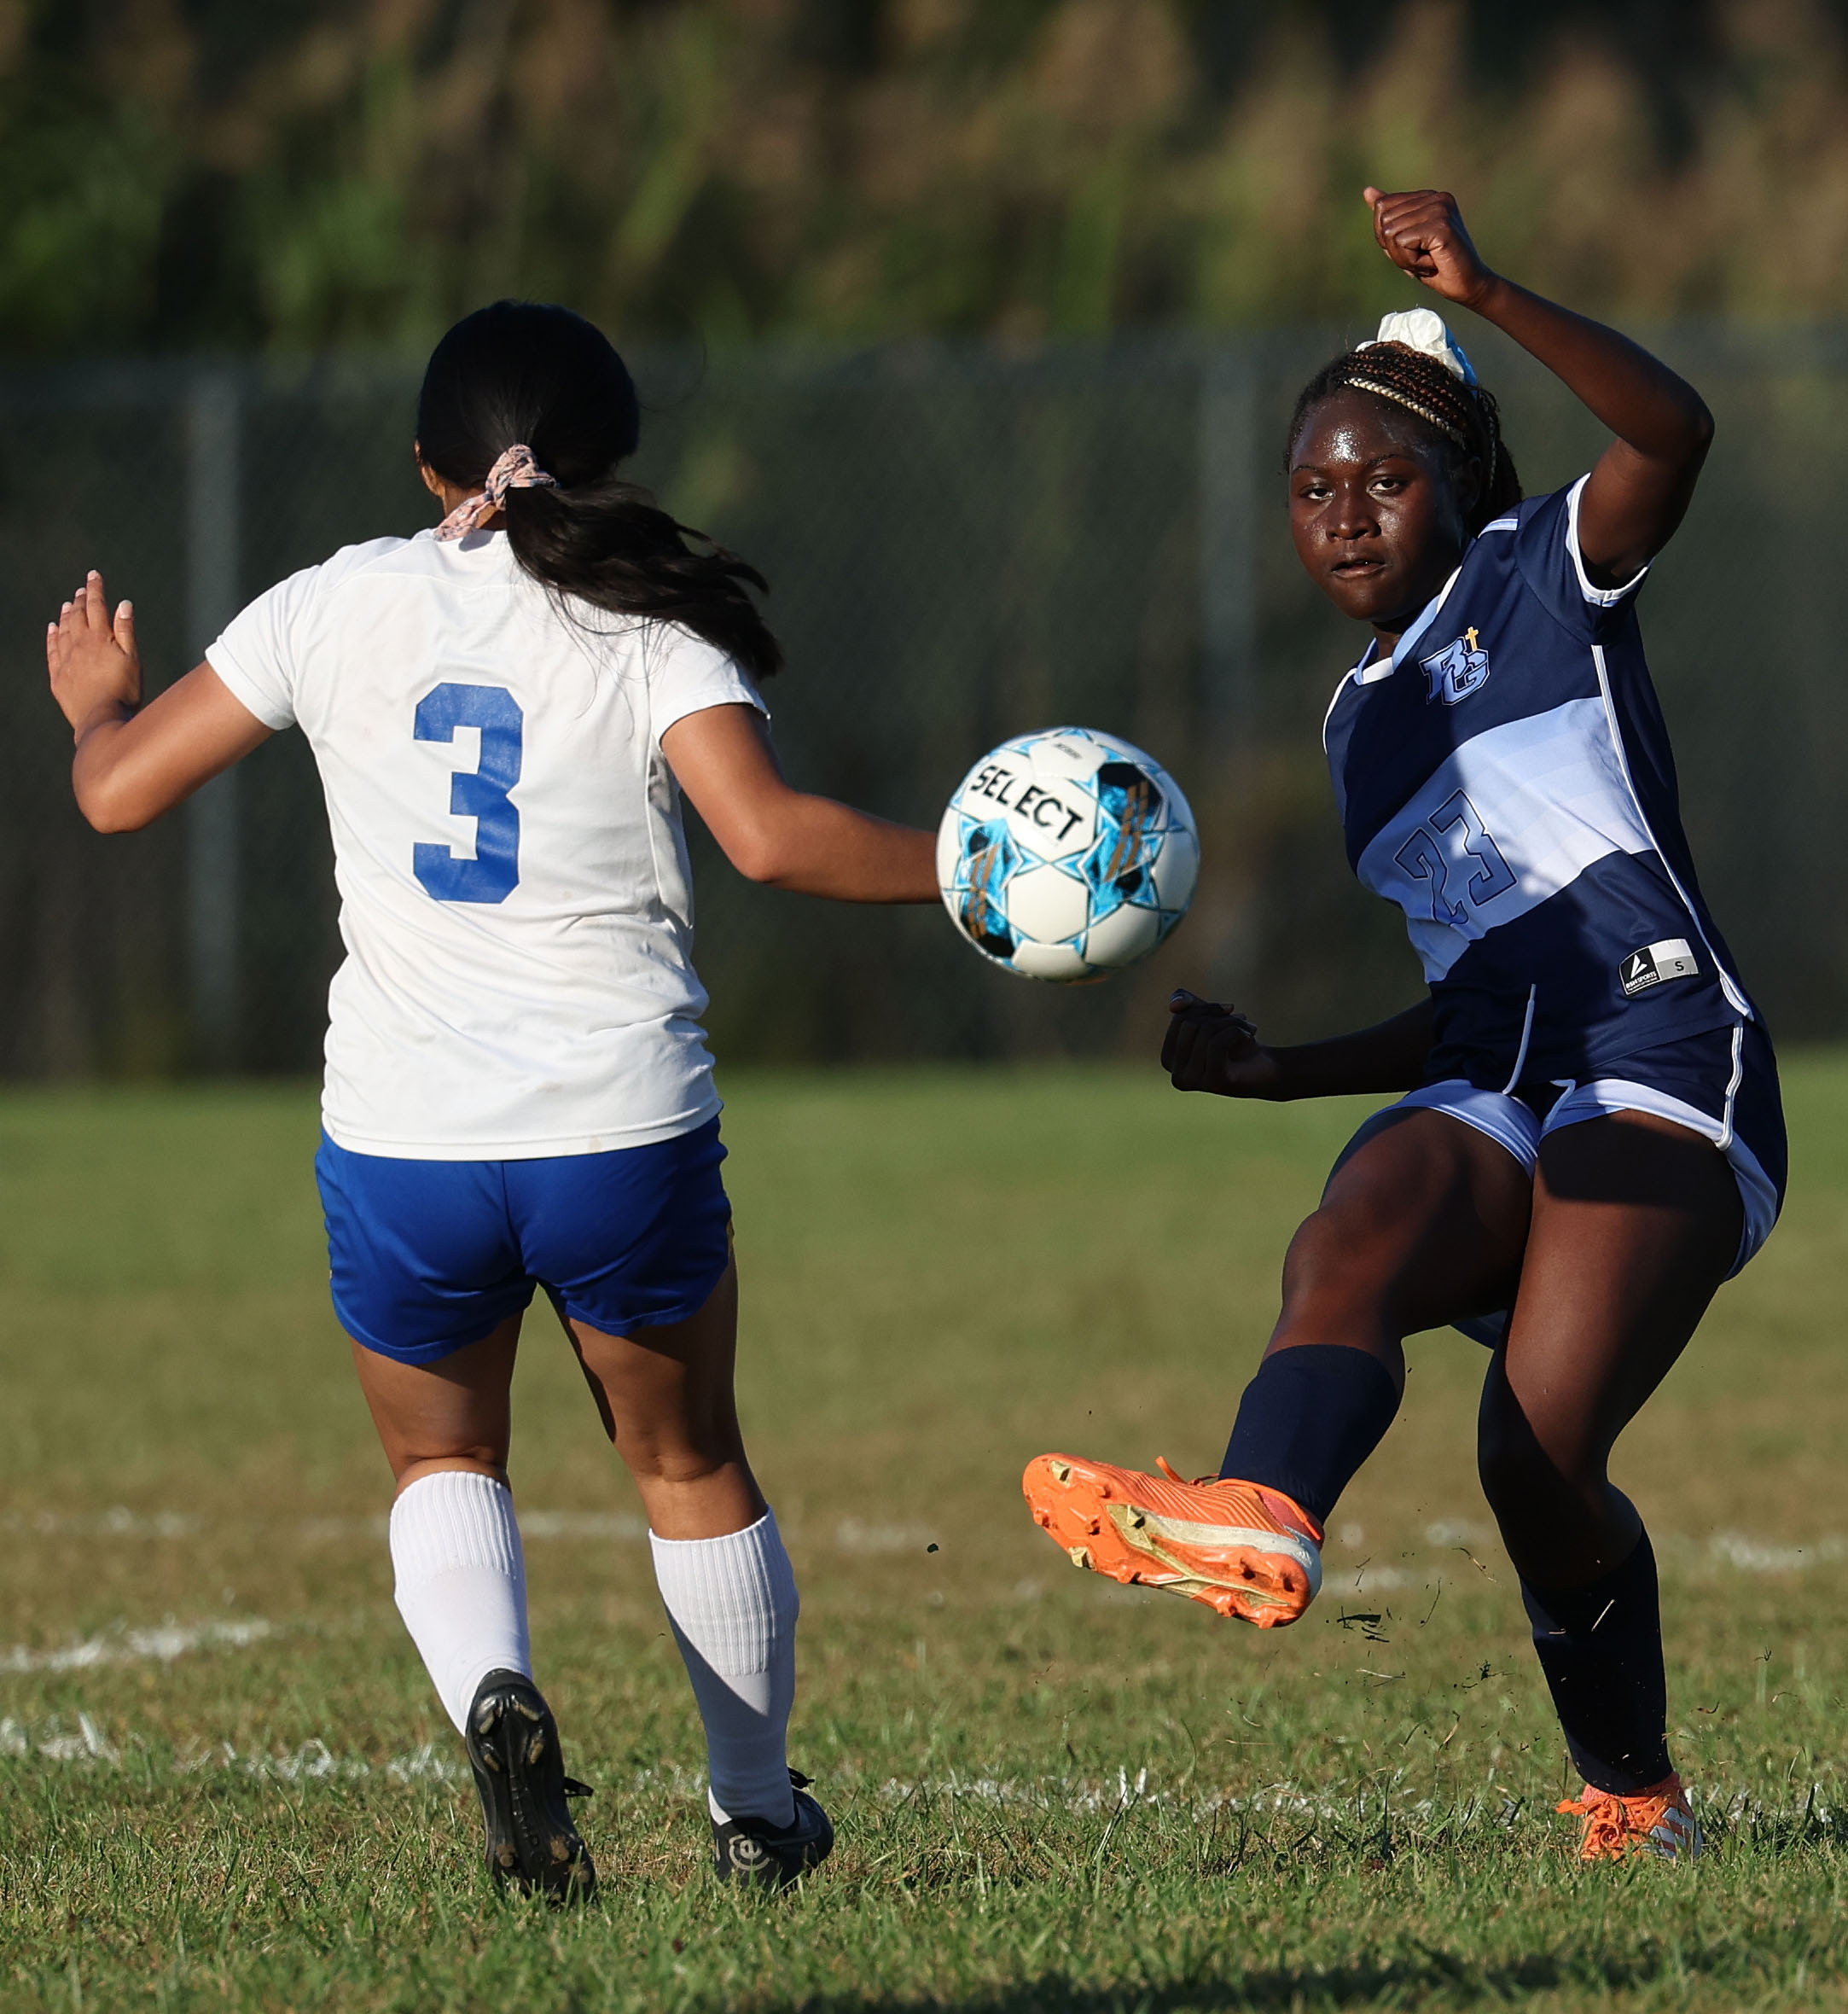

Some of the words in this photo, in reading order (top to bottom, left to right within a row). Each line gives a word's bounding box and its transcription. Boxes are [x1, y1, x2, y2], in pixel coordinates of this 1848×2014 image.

[413, 682, 523, 904] 3
[970, 765, 1084, 841] SELECT
[1393, 788, 1517, 927] 23
[1675, 961, 1684, 971] S
